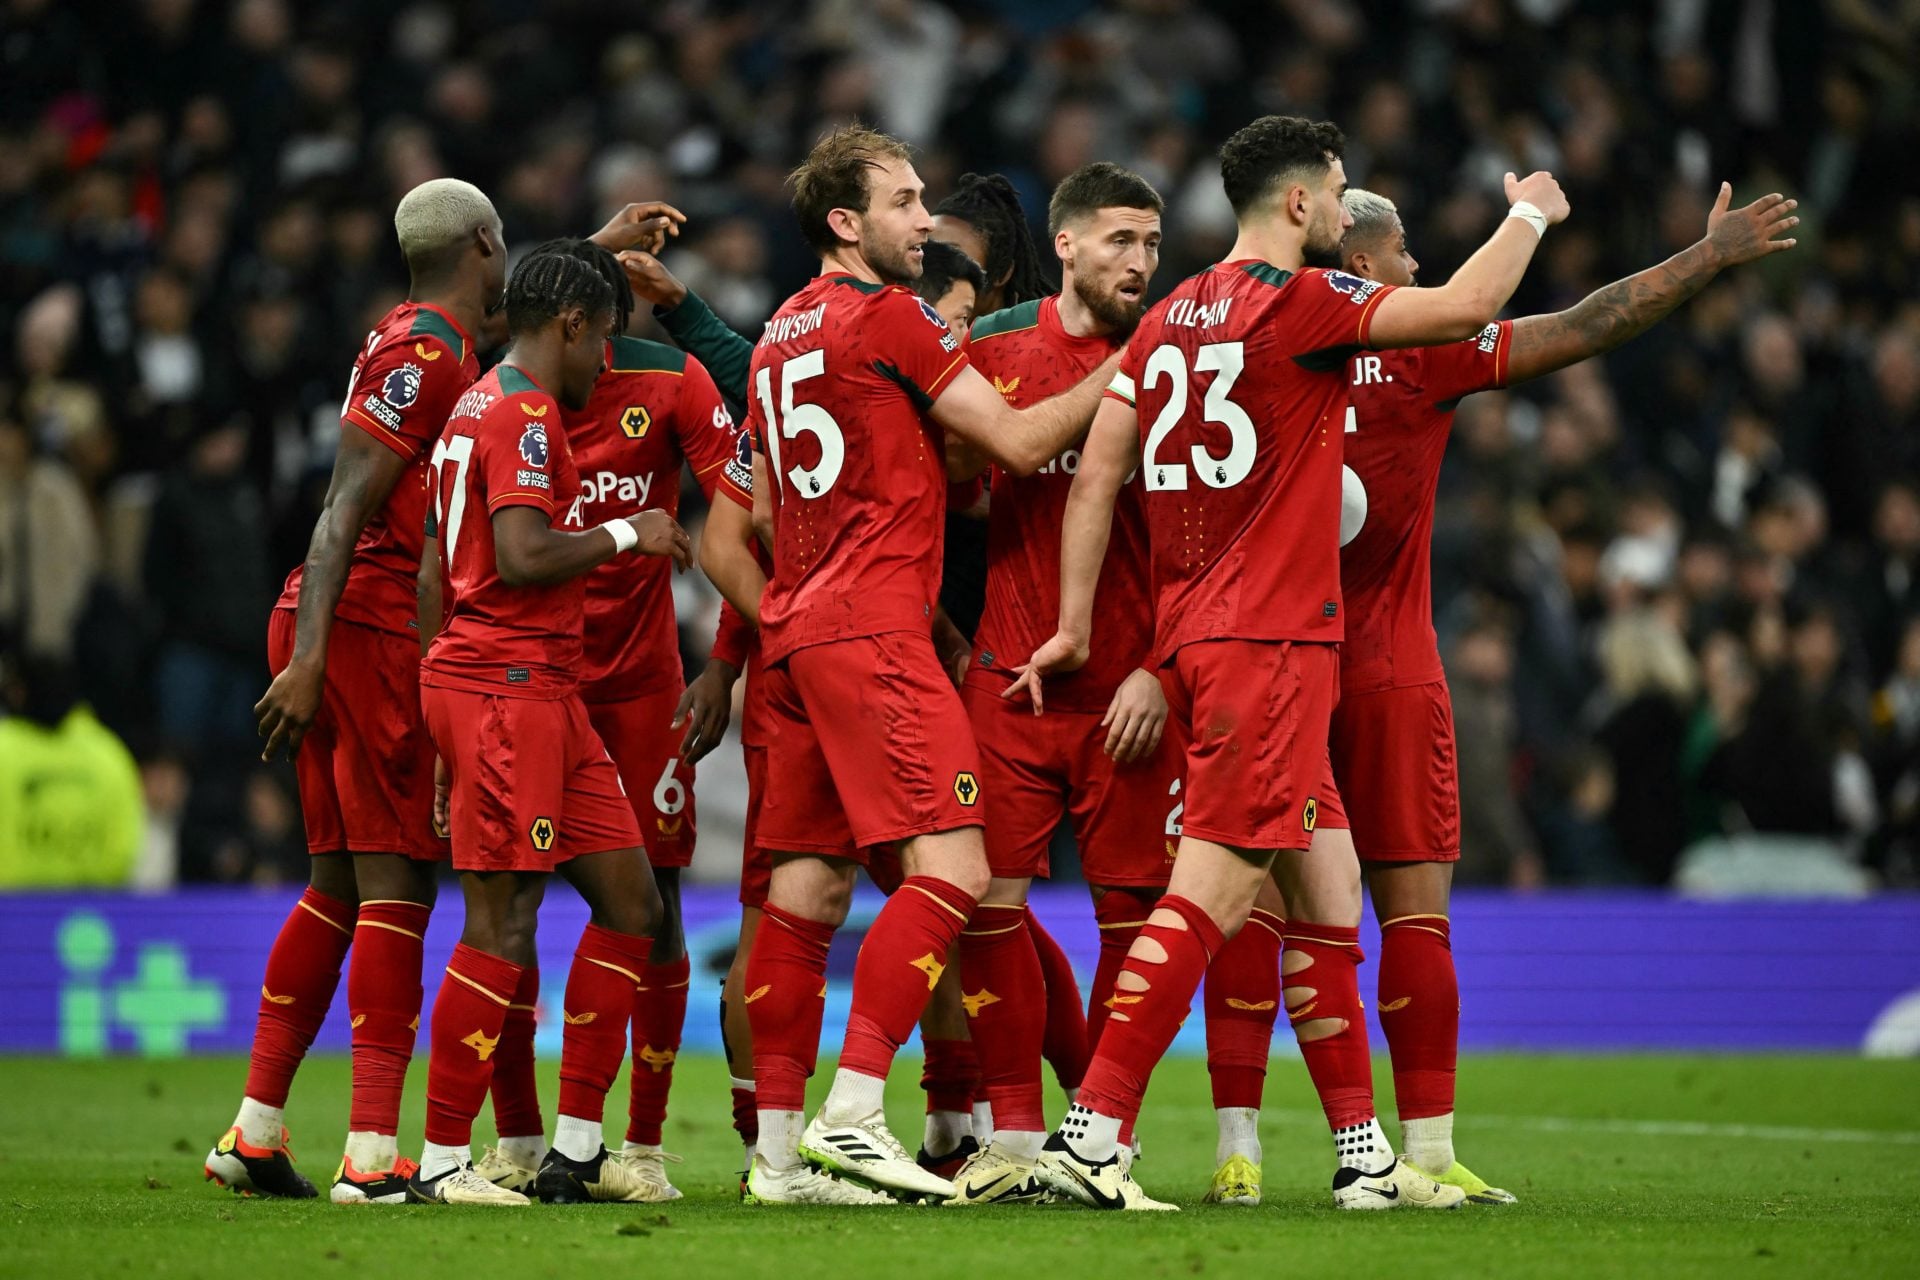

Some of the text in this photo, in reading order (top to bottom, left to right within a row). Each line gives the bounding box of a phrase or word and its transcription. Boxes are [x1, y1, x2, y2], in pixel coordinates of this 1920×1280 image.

[760, 302, 827, 348] DAWSON
[1165, 297, 1233, 329] KILMAN
[1353, 356, 1393, 385] JR.
[366, 394, 401, 424] No room
[756, 349, 845, 506] 15
[1143, 341, 1258, 492] 23
[517, 469, 531, 479] No
[653, 758, 686, 815] 6
